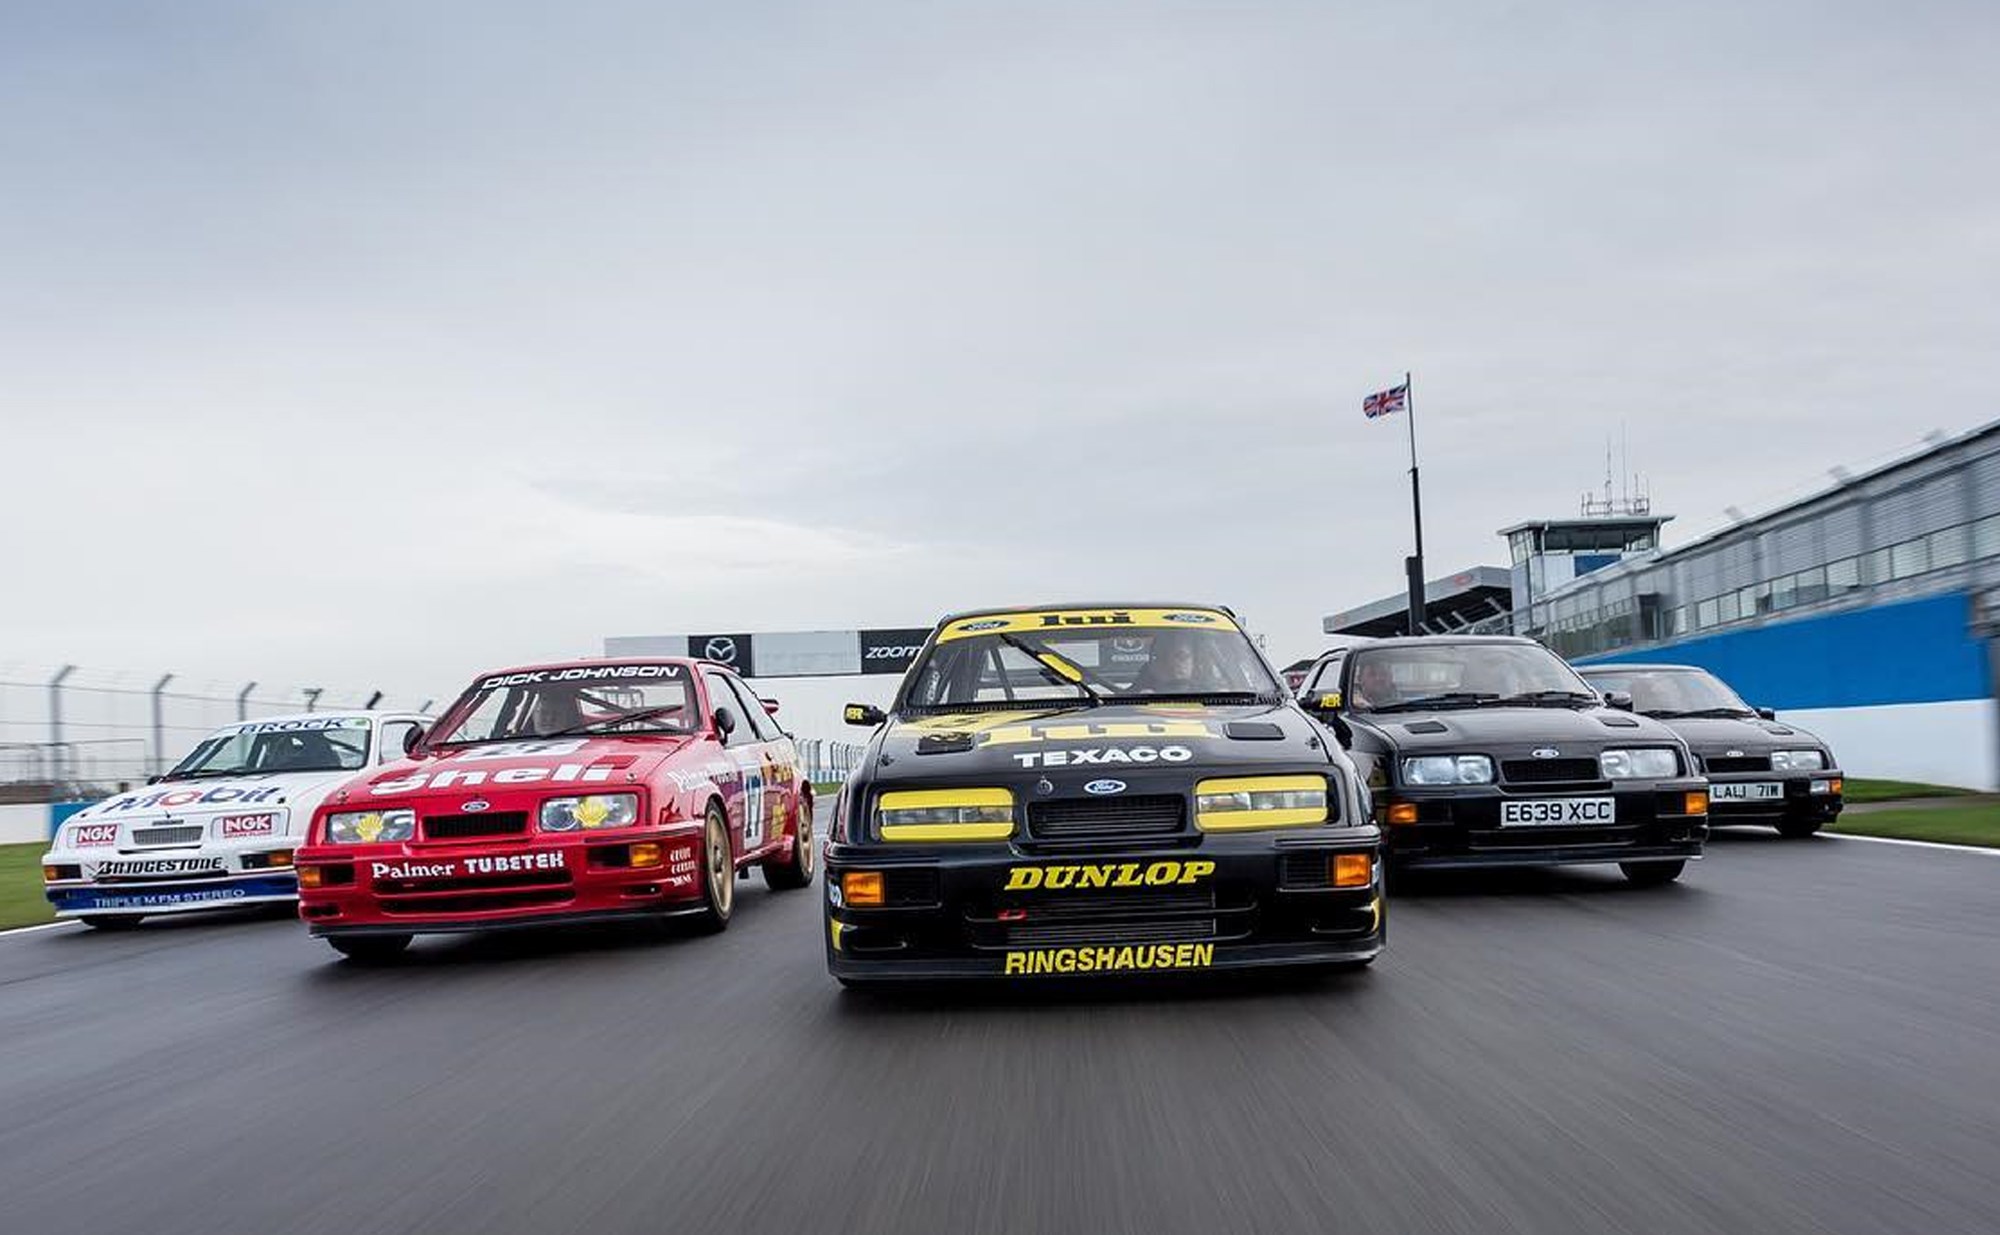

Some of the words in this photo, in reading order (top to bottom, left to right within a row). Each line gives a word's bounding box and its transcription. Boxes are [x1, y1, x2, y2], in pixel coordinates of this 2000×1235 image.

[865, 645, 921, 659] zoom
[482, 671, 549, 690] DICK
[550, 666, 679, 681] JOHNSON
[239, 719, 343, 735] BROCK
[1013, 745, 1193, 768] TEXACO
[102, 786, 281, 813] Mobil
[1506, 803, 1562, 822] E639
[1568, 801, 1610, 820] XCC
[225, 814, 273, 832] NGK
[78, 827, 117, 843] NGK
[97, 857, 224, 874] BRIDGESTONE
[371, 862, 455, 878] Palmer
[1004, 861, 1216, 890] DUNLOP
[1004, 943, 1214, 975] RINGSHAUSEN
